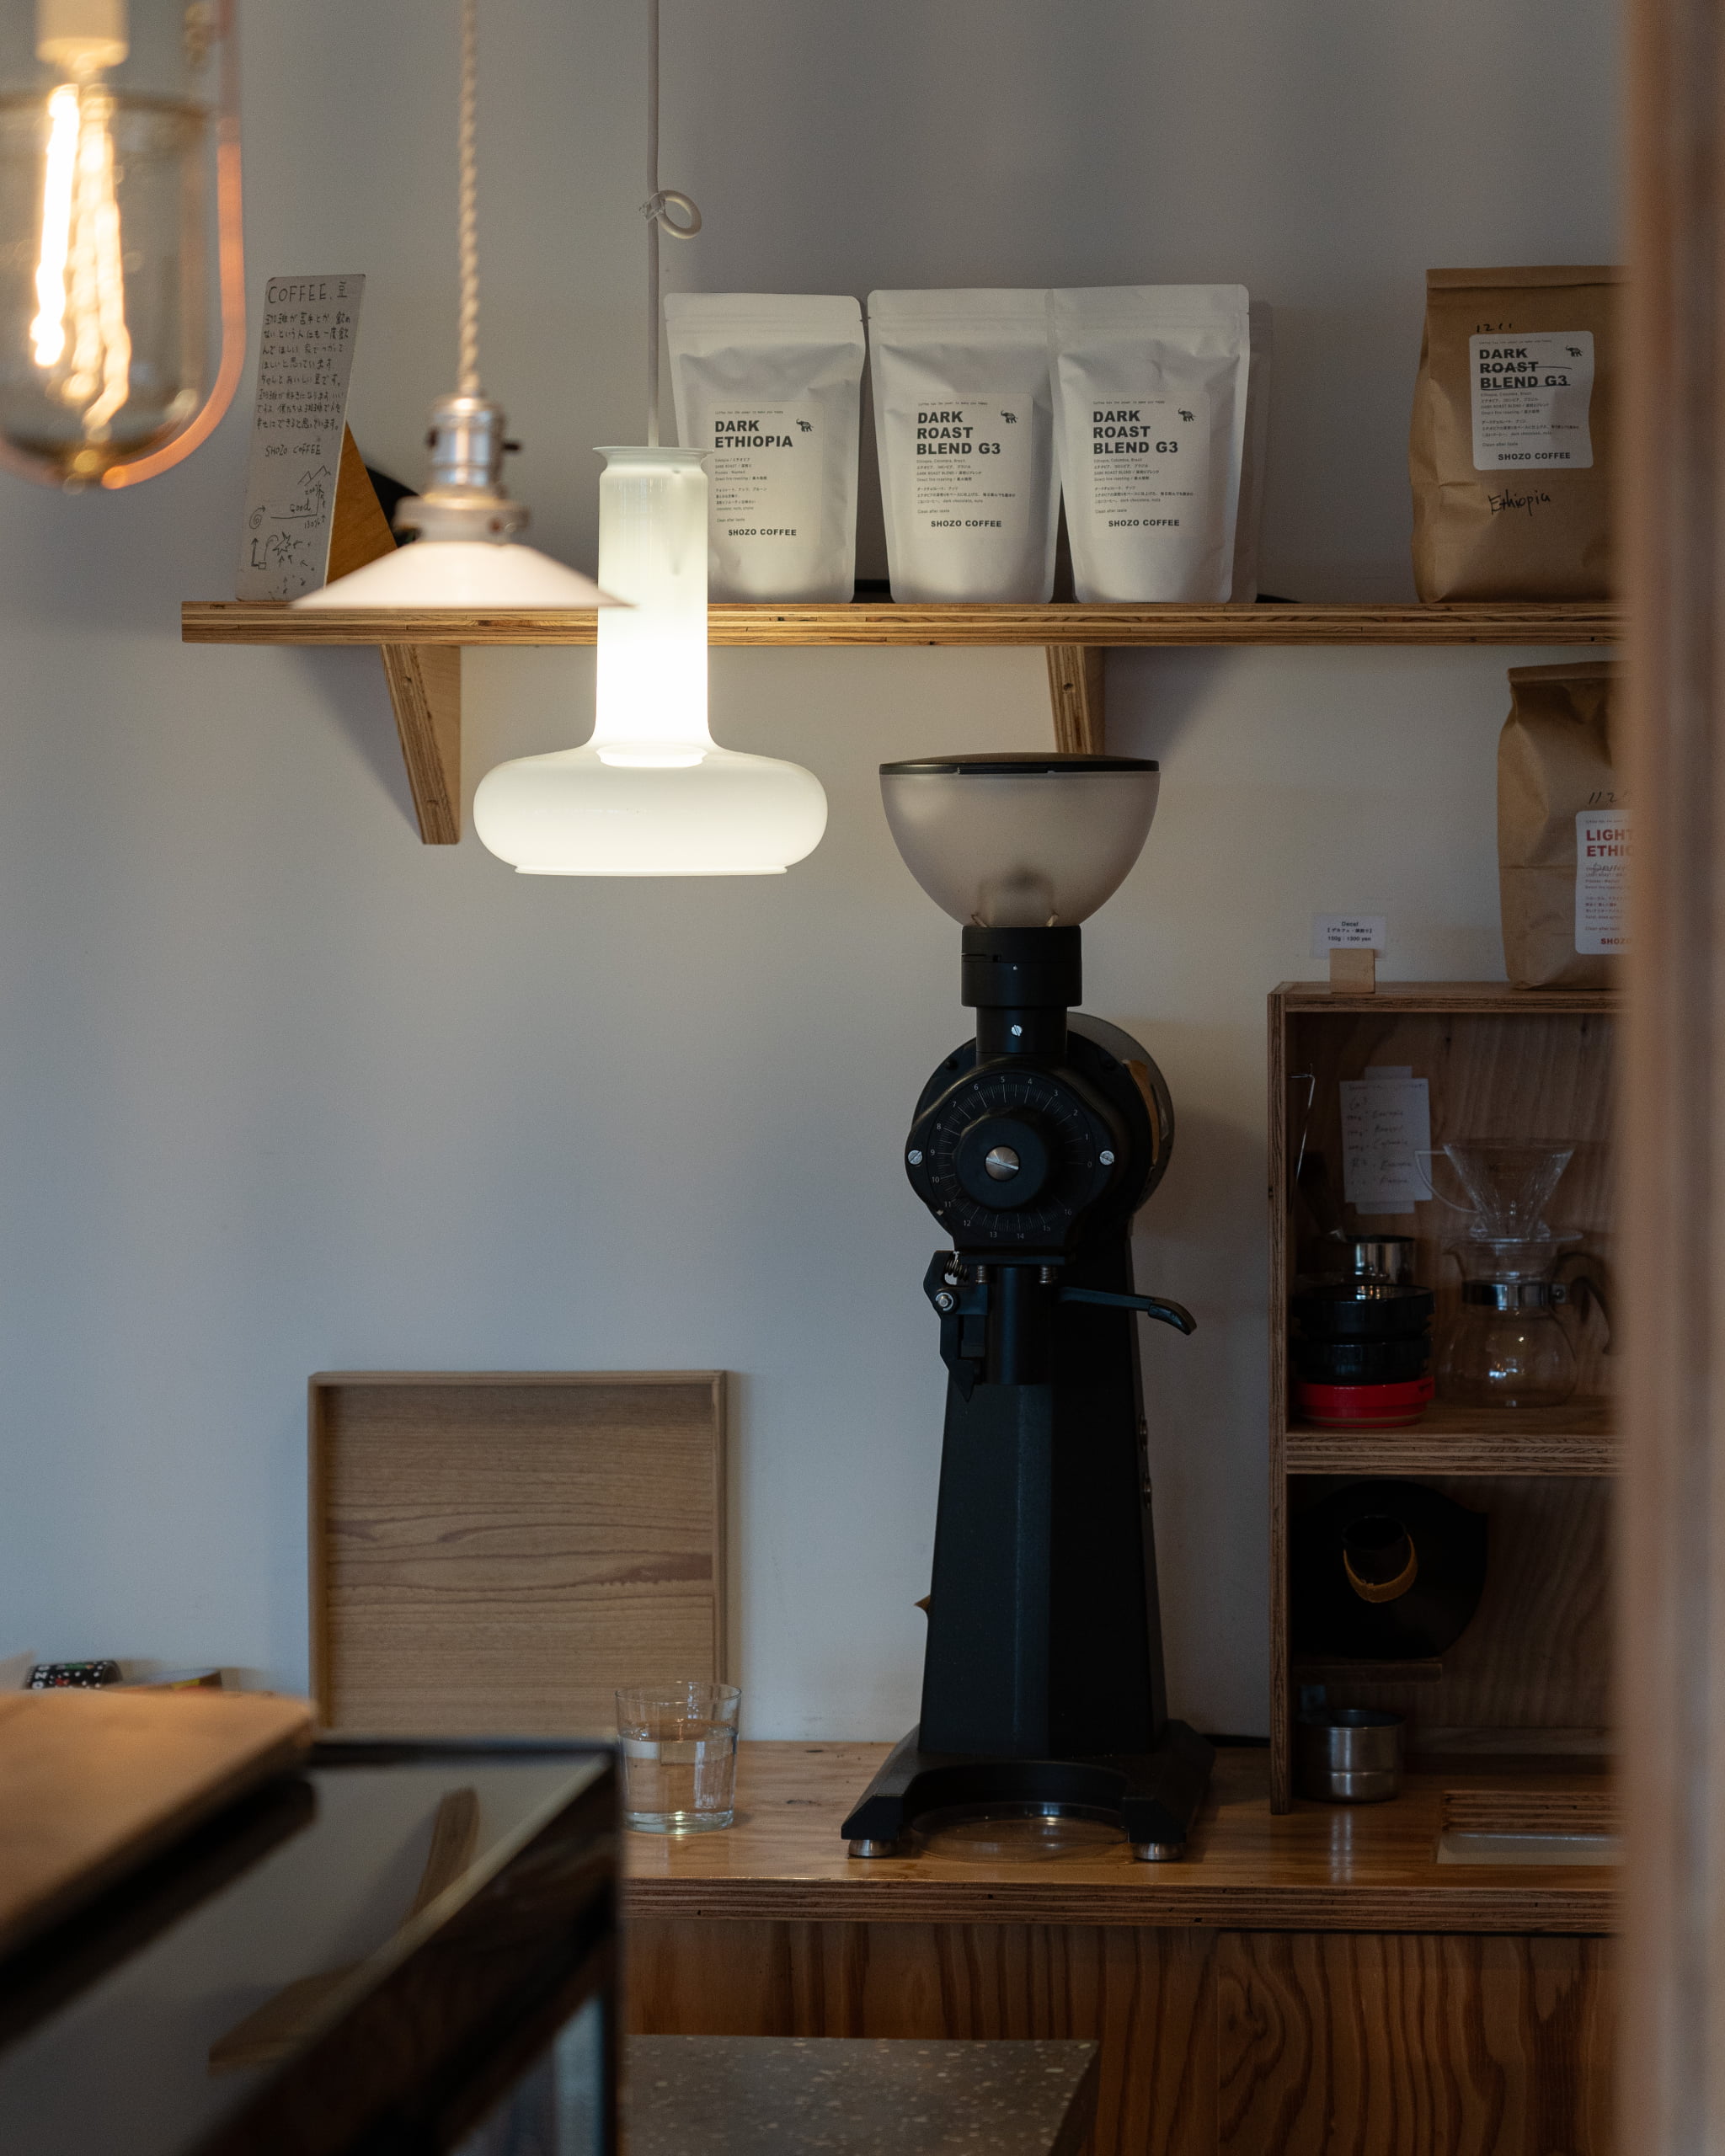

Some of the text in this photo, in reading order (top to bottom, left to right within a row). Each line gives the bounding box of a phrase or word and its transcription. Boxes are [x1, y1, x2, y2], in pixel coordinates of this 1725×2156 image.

[1479, 348, 1528, 359] DARK
[1480, 361, 1539, 373] ROAST
[1481, 376, 1567, 388] BLEND G3
[918, 411, 964, 424] DARK
[1092, 409, 1140, 423] DARK
[715, 420, 760, 432] DARK
[1093, 426, 1151, 438] ROAST
[916, 427, 974, 439] ROAST
[715, 435, 793, 448] ETHIOPIA
[1093, 441, 1178, 455] BLEND G3
[293, 443, 321, 456] COFFEE
[916, 442, 1001, 455] BLEND G3
[1488, 489, 1551, 515] Ethiopia
